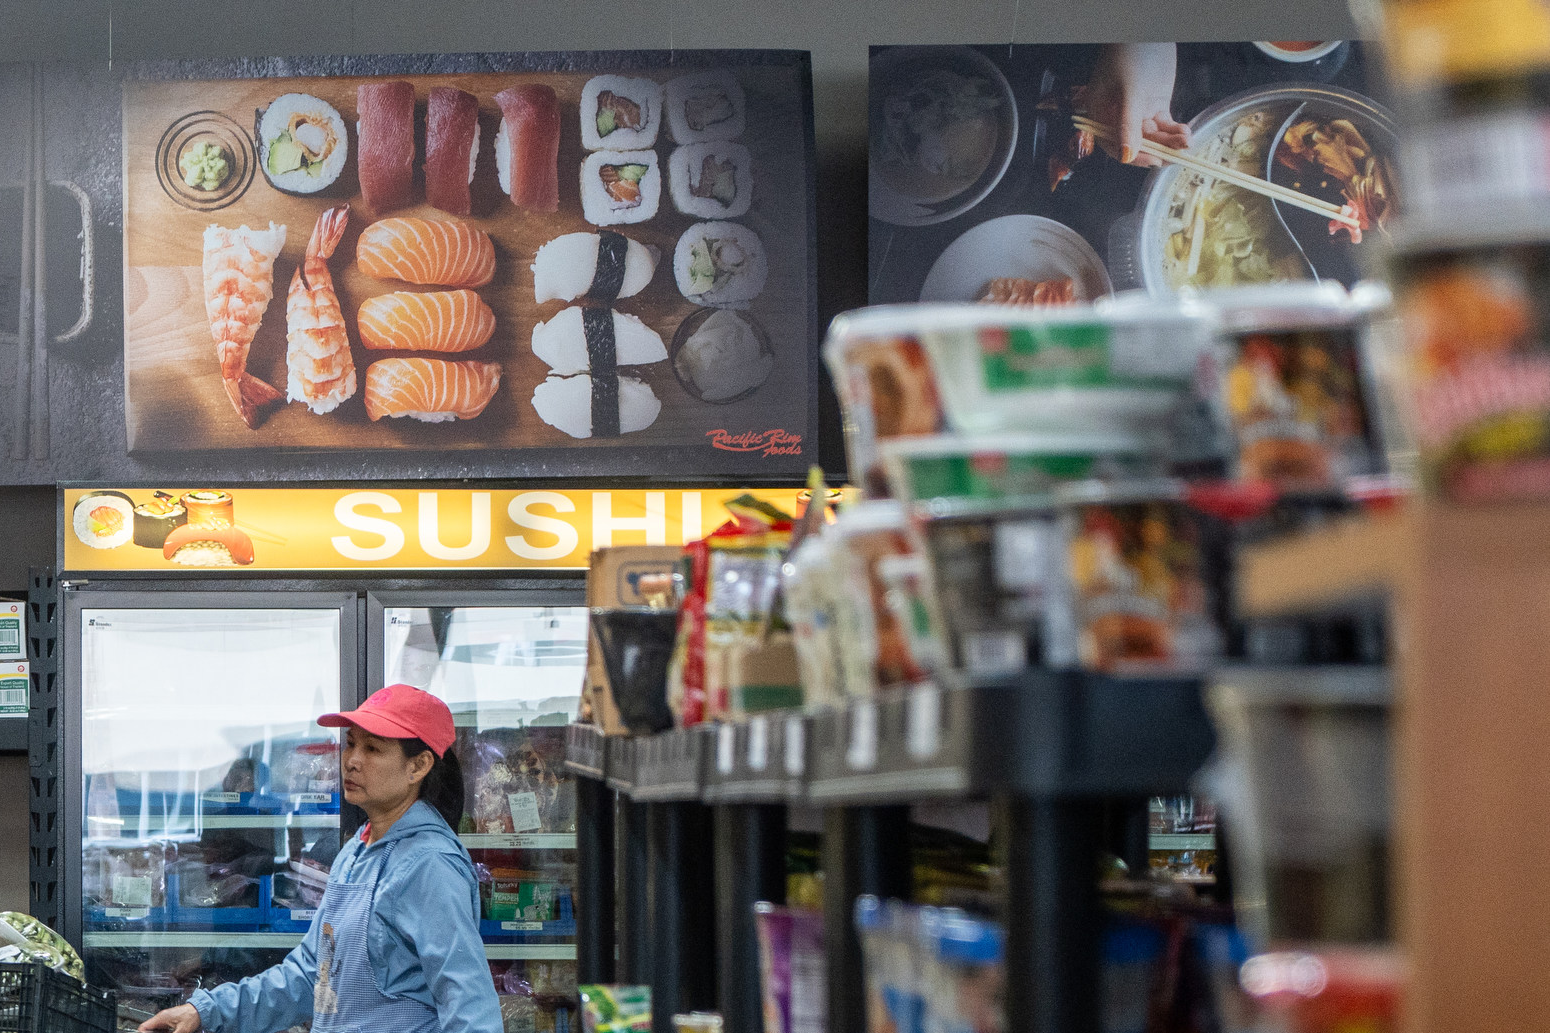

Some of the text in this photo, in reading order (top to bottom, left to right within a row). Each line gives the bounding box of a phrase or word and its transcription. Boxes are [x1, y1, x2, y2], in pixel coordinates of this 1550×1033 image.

[706, 429, 802, 450] Pacific Rim
[762, 442, 802, 458] Foods
[330, 491, 702, 561] SUSHI
